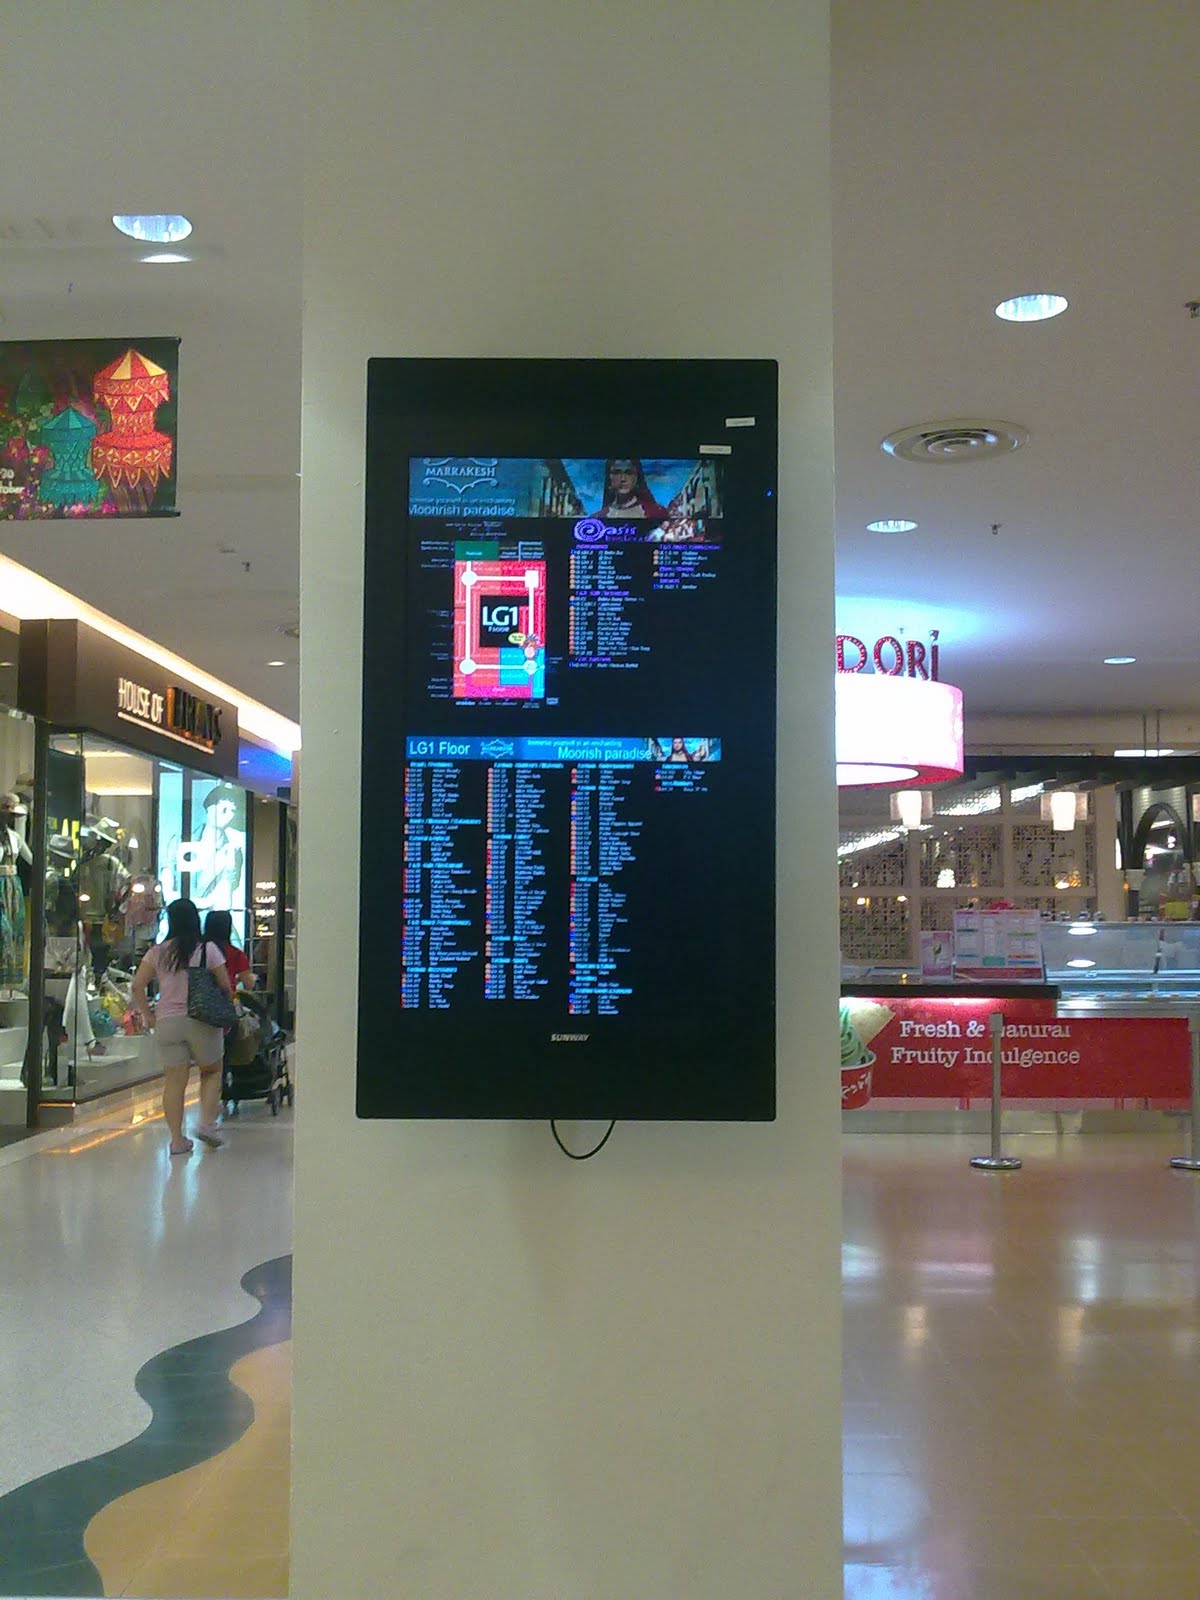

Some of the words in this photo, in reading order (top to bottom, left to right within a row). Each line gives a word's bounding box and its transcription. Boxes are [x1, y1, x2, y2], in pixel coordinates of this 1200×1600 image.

[425, 467, 496, 477] MARRAKESH
[464, 504, 515, 519] paradise
[482, 606, 518, 625] LG1
[118, 677, 150, 719] HOUSE
[151, 692, 165, 724] OF
[409, 741, 435, 755] LG1
[439, 741, 470, 755] Floor
[558, 746, 602, 759] Moorish
[605, 747, 652, 761] paradise
[900, 1020, 961, 1038] Fresh
[966, 1020, 985, 1038] &
[989, 1024, 1071, 1038] atural
[891, 1046, 959, 1068] Fruity
